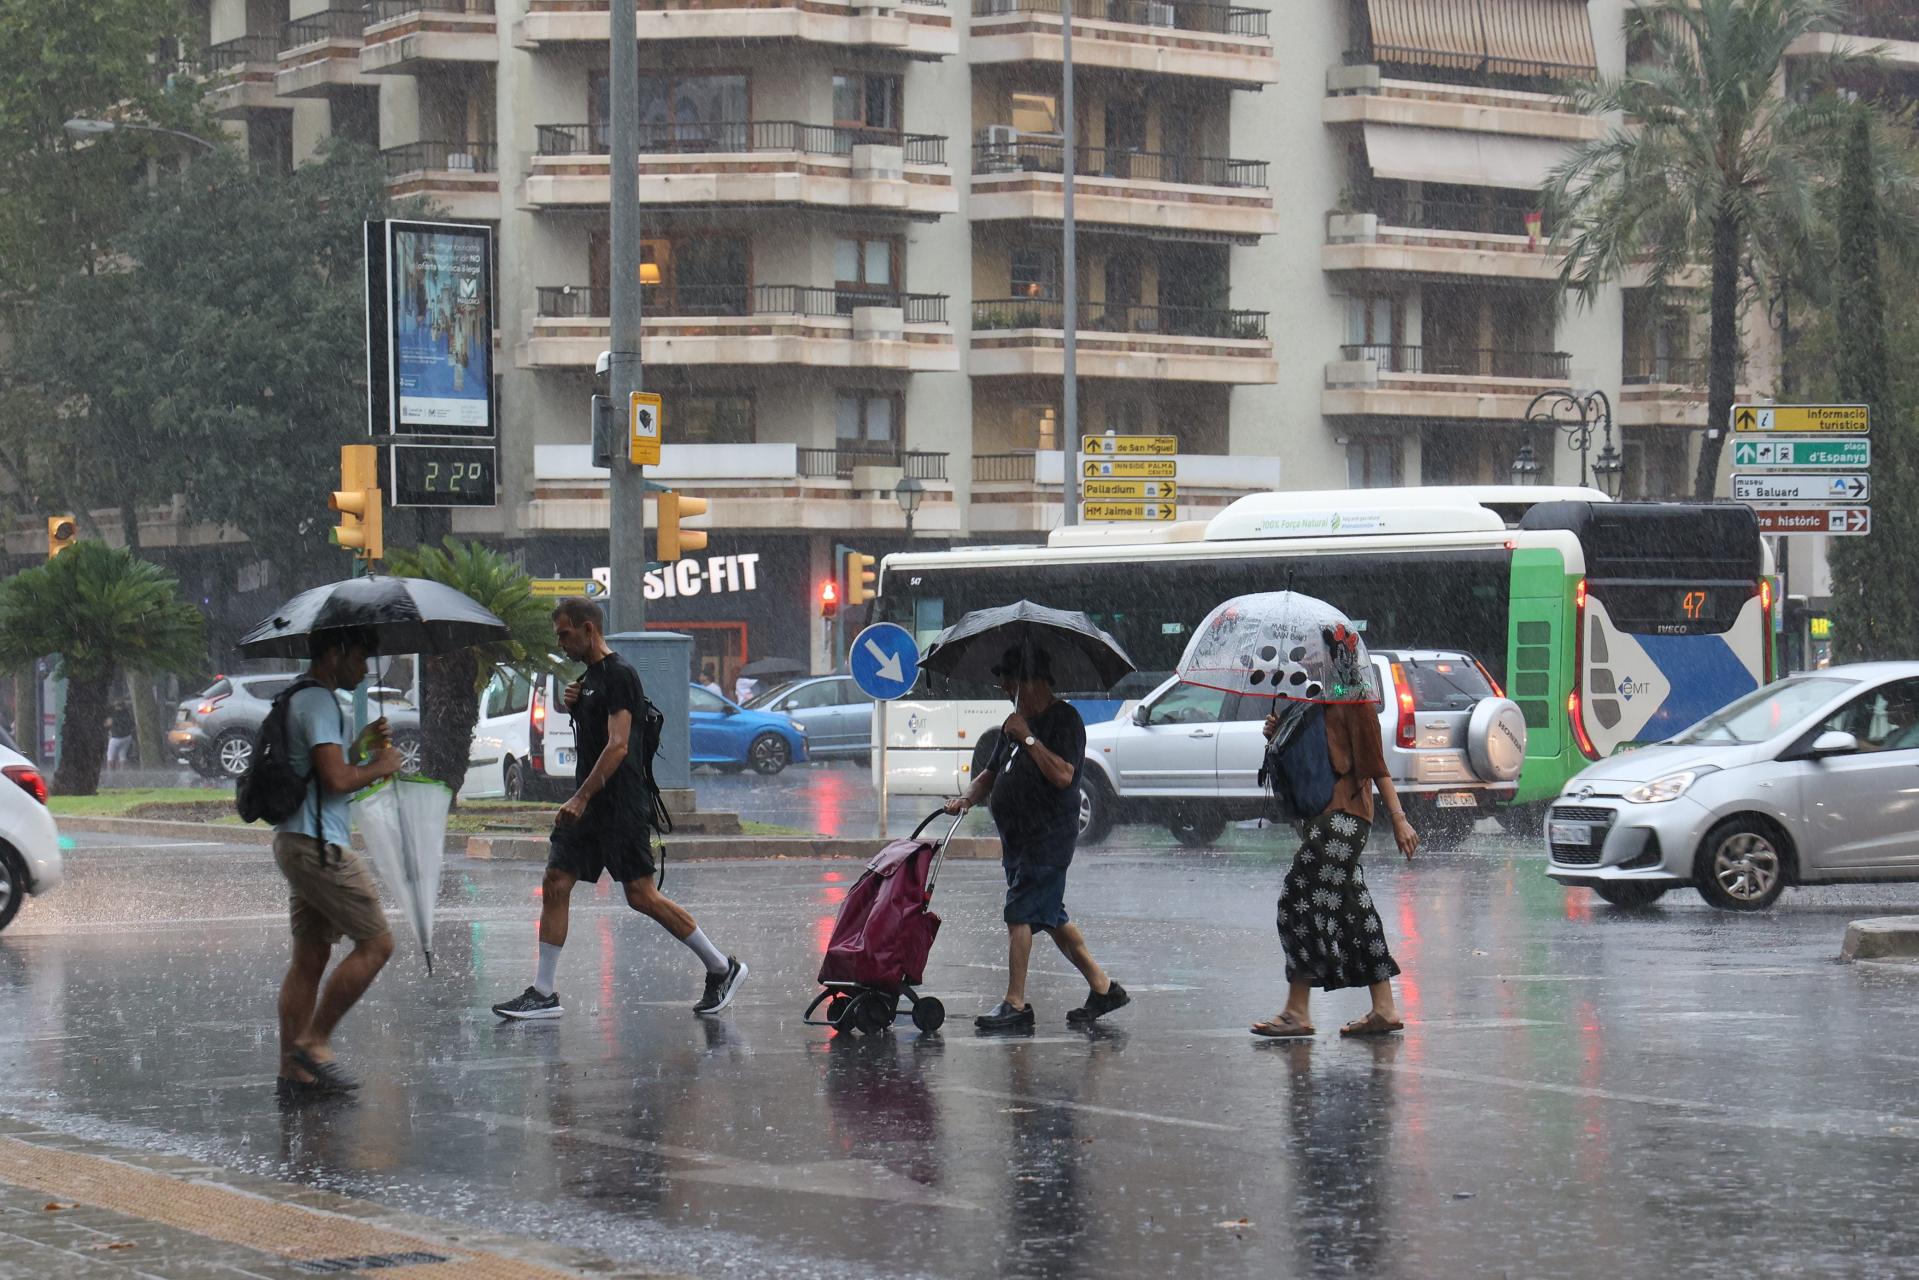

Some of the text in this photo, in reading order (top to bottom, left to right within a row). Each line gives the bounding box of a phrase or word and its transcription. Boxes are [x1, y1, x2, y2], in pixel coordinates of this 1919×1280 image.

[1807, 409, 1866, 419] Informació
[1129, 444, 1145, 452] San
[1147, 444, 1174, 454] Miguel
[1844, 442, 1866, 452] plaça
[1809, 453, 1866, 464] d'Espanya
[1086, 485, 1136, 494] Palladium
[1737, 487, 1799, 497] Es Baluard
[1086, 507, 1144, 516] HM Jaime III
[1778, 515, 1820, 526] històric
[592, 553, 760, 600] BSIC-FIT
[910, 577, 922, 586] 547
[1682, 591, 1706, 619] 47
[1271, 623, 1298, 633] MAKE IT
[1657, 625, 1688, 634] IVECO
[1273, 630, 1289, 640] RAIN
[1498, 720, 1522, 754] HONDA
